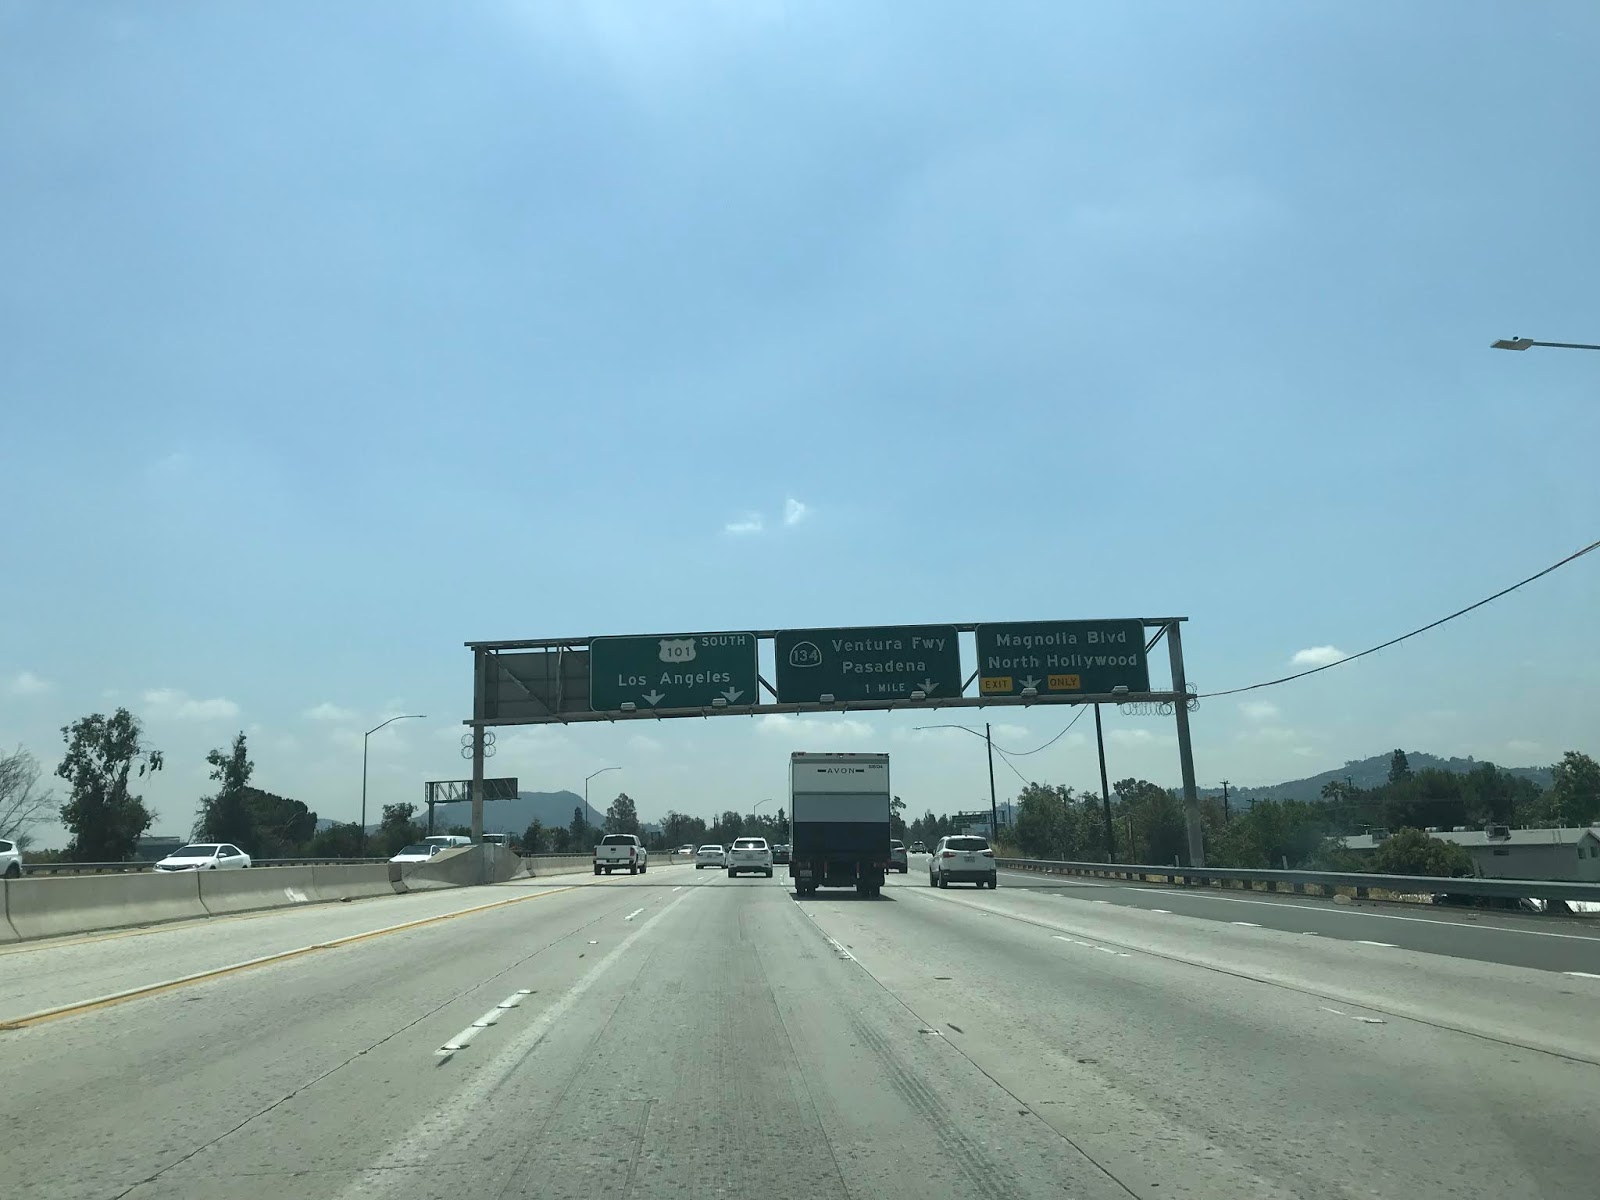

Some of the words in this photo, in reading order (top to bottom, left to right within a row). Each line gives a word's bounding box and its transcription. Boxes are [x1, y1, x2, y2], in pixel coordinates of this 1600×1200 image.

[701, 635, 746, 647] SOUTH
[832, 638, 902, 652] Ventura
[911, 636, 945, 651] Fwy
[996, 632, 1077, 649] Magnolia
[1087, 630, 1126, 644] Blvd
[667, 646, 690, 657] 101
[793, 650, 818, 662] 134
[842, 660, 926, 674] Pasadena
[988, 654, 1039, 669] North
[1047, 653, 1138, 669] Hollywood
[618, 674, 647, 686] Los
[660, 670, 731, 688] Angeles
[985, 679, 1008, 689] EXIT
[1050, 677, 1078, 687] ONLY
[865, 683, 870, 693] 1
[878, 683, 905, 692] MILE
